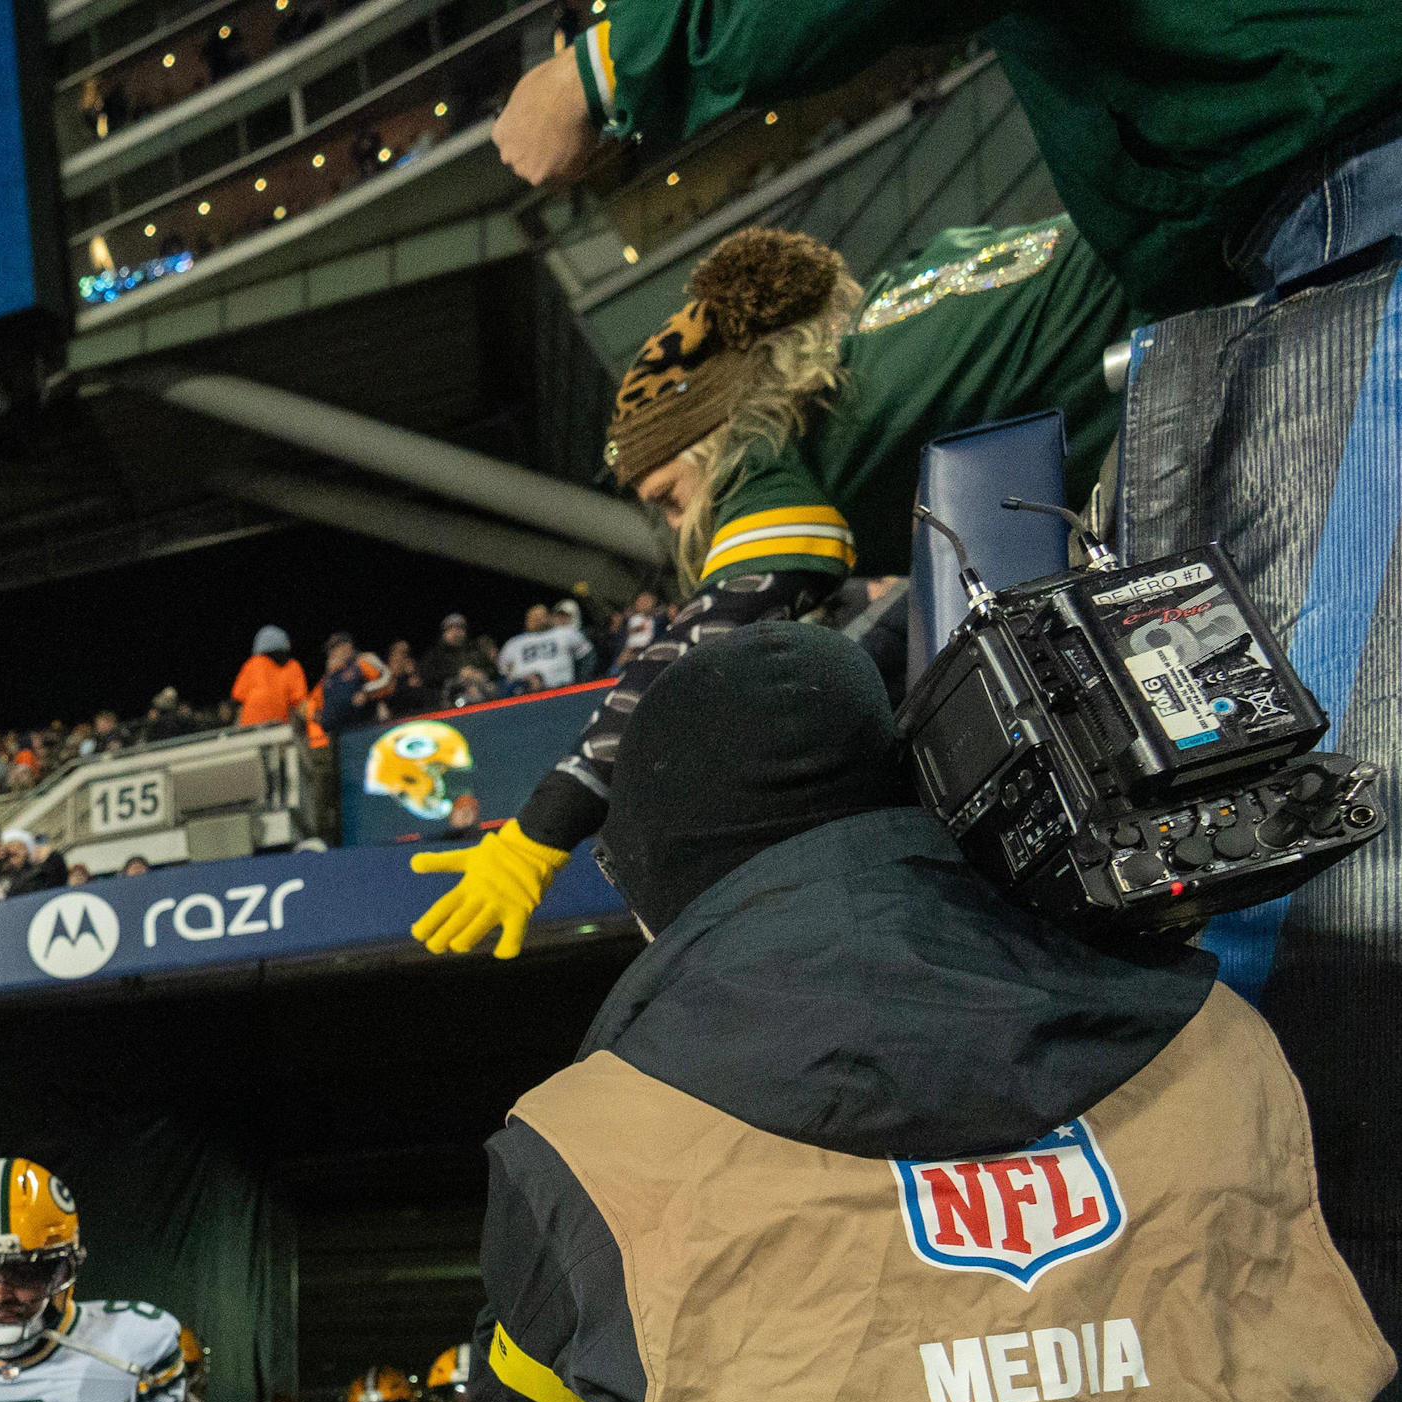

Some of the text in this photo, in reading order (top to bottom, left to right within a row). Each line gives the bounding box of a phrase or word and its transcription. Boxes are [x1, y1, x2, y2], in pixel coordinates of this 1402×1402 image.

[1182, 566, 1202, 582] #7
[1144, 678, 1162, 691] 6
[1150, 686, 1179, 717] FOX
[96, 780, 159, 824] 155
[143, 878, 305, 948] razr
[921, 1154, 1101, 1255] NFL
